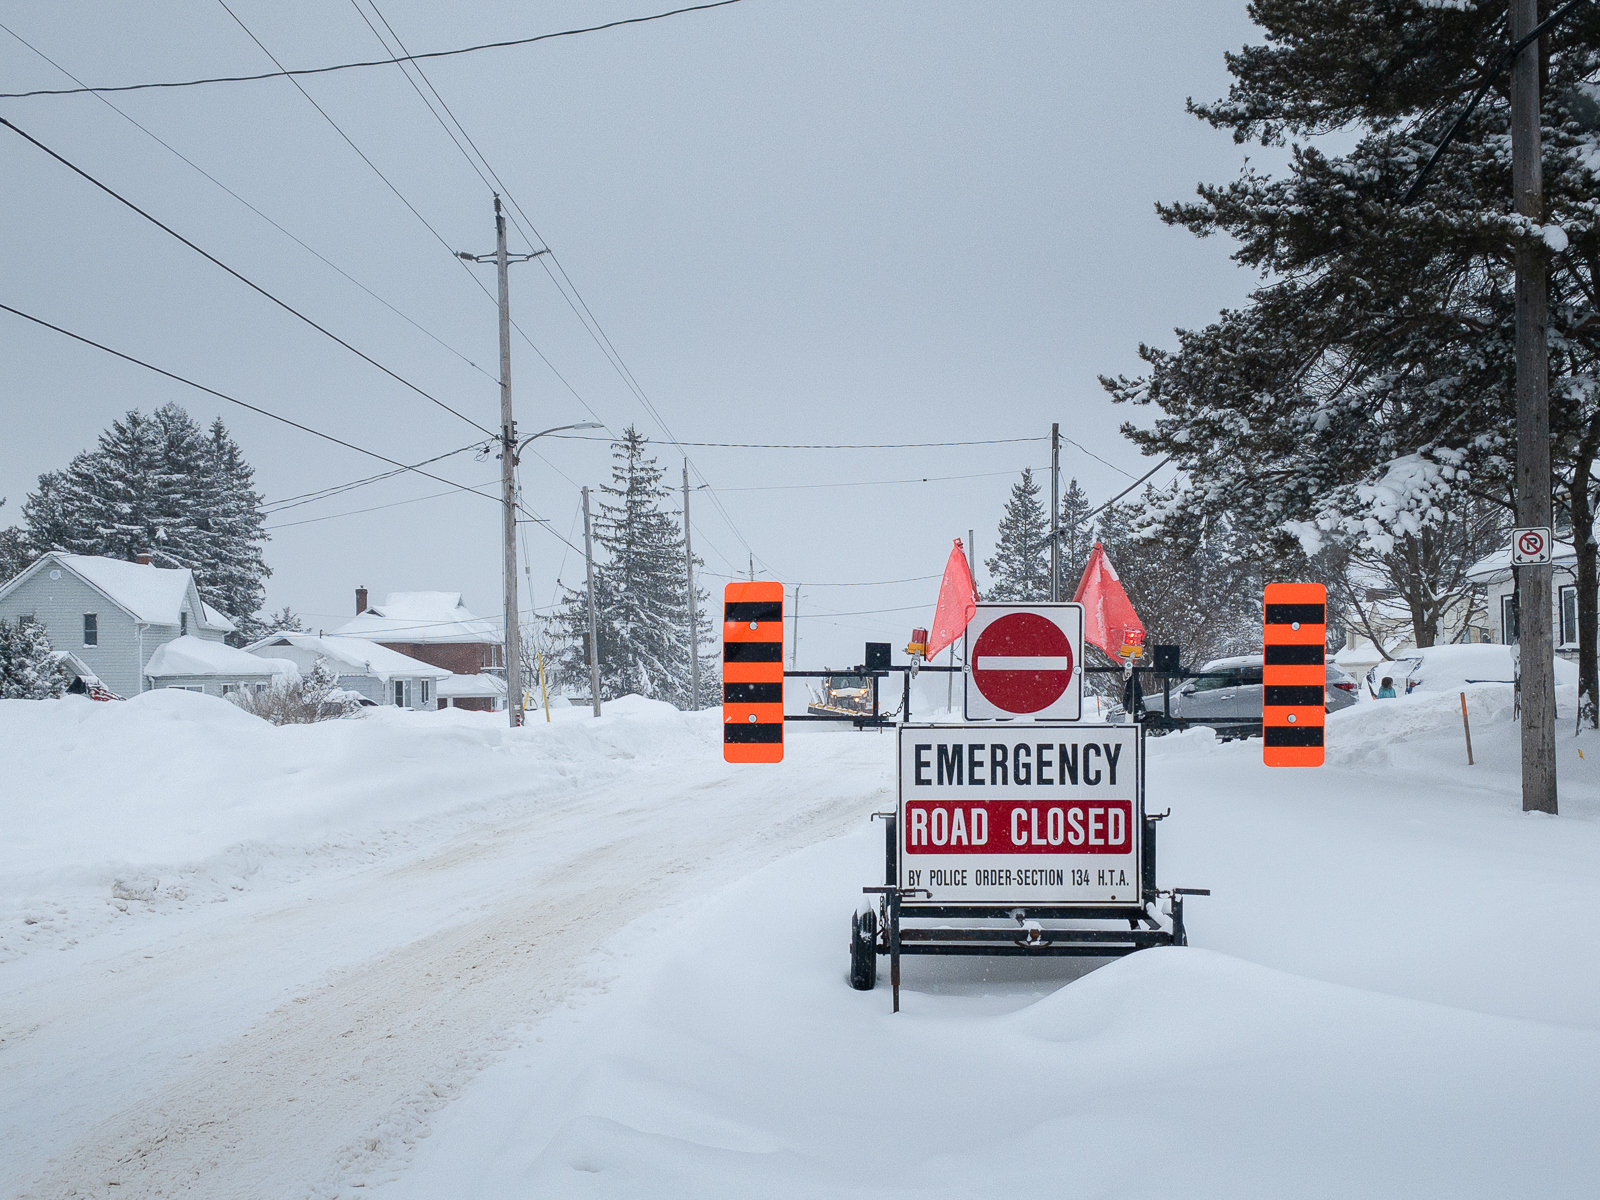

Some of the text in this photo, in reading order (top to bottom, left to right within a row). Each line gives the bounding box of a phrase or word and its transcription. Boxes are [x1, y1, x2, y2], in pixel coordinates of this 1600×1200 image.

[914, 743, 1122, 786] EMERGENCY
[911, 807, 1126, 846] ROAD CLOSED
[908, 869, 1130, 887] BY POLICE ORDER-SECTION 134 H.T.A.
